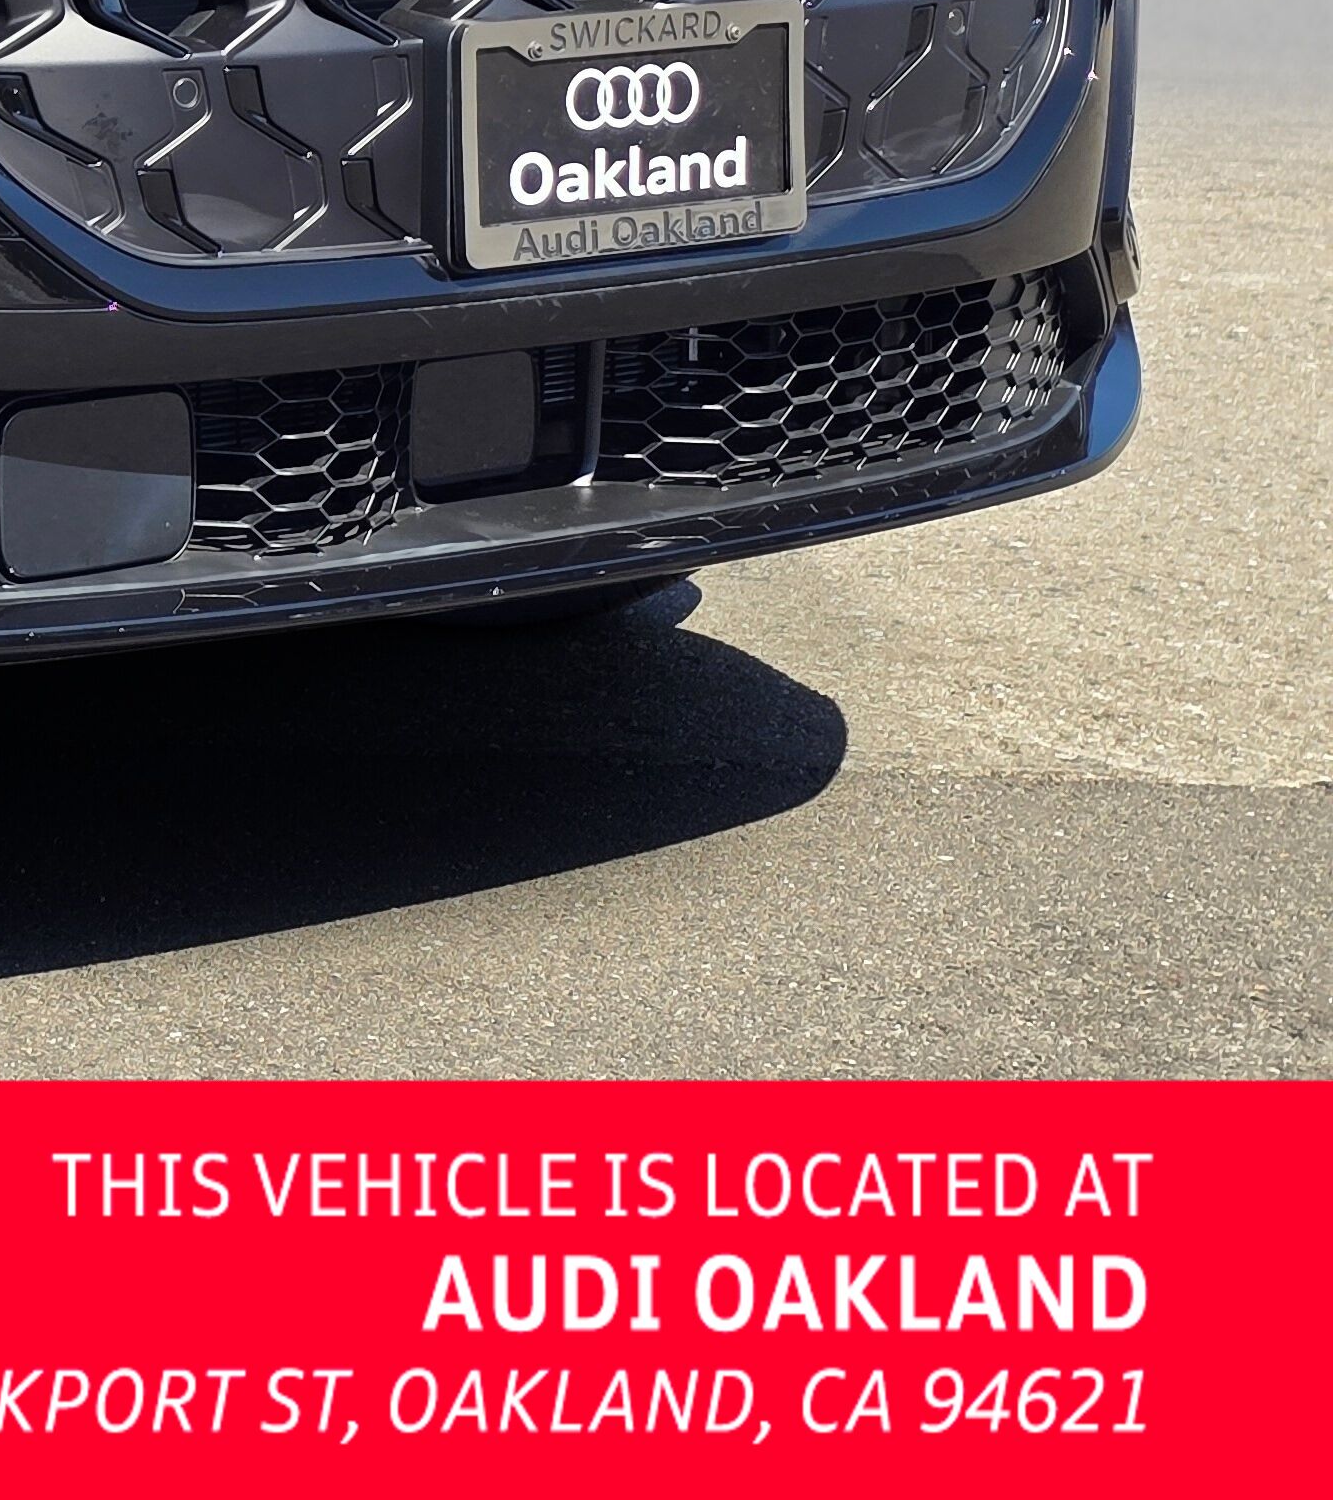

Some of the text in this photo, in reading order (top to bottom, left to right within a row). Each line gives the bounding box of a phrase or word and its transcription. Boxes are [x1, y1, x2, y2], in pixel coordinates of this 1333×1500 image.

[549, 10, 722, 51] SWICKARD
[509, 135, 747, 206] Oakland
[512, 201, 762, 262] Audi Oakland
